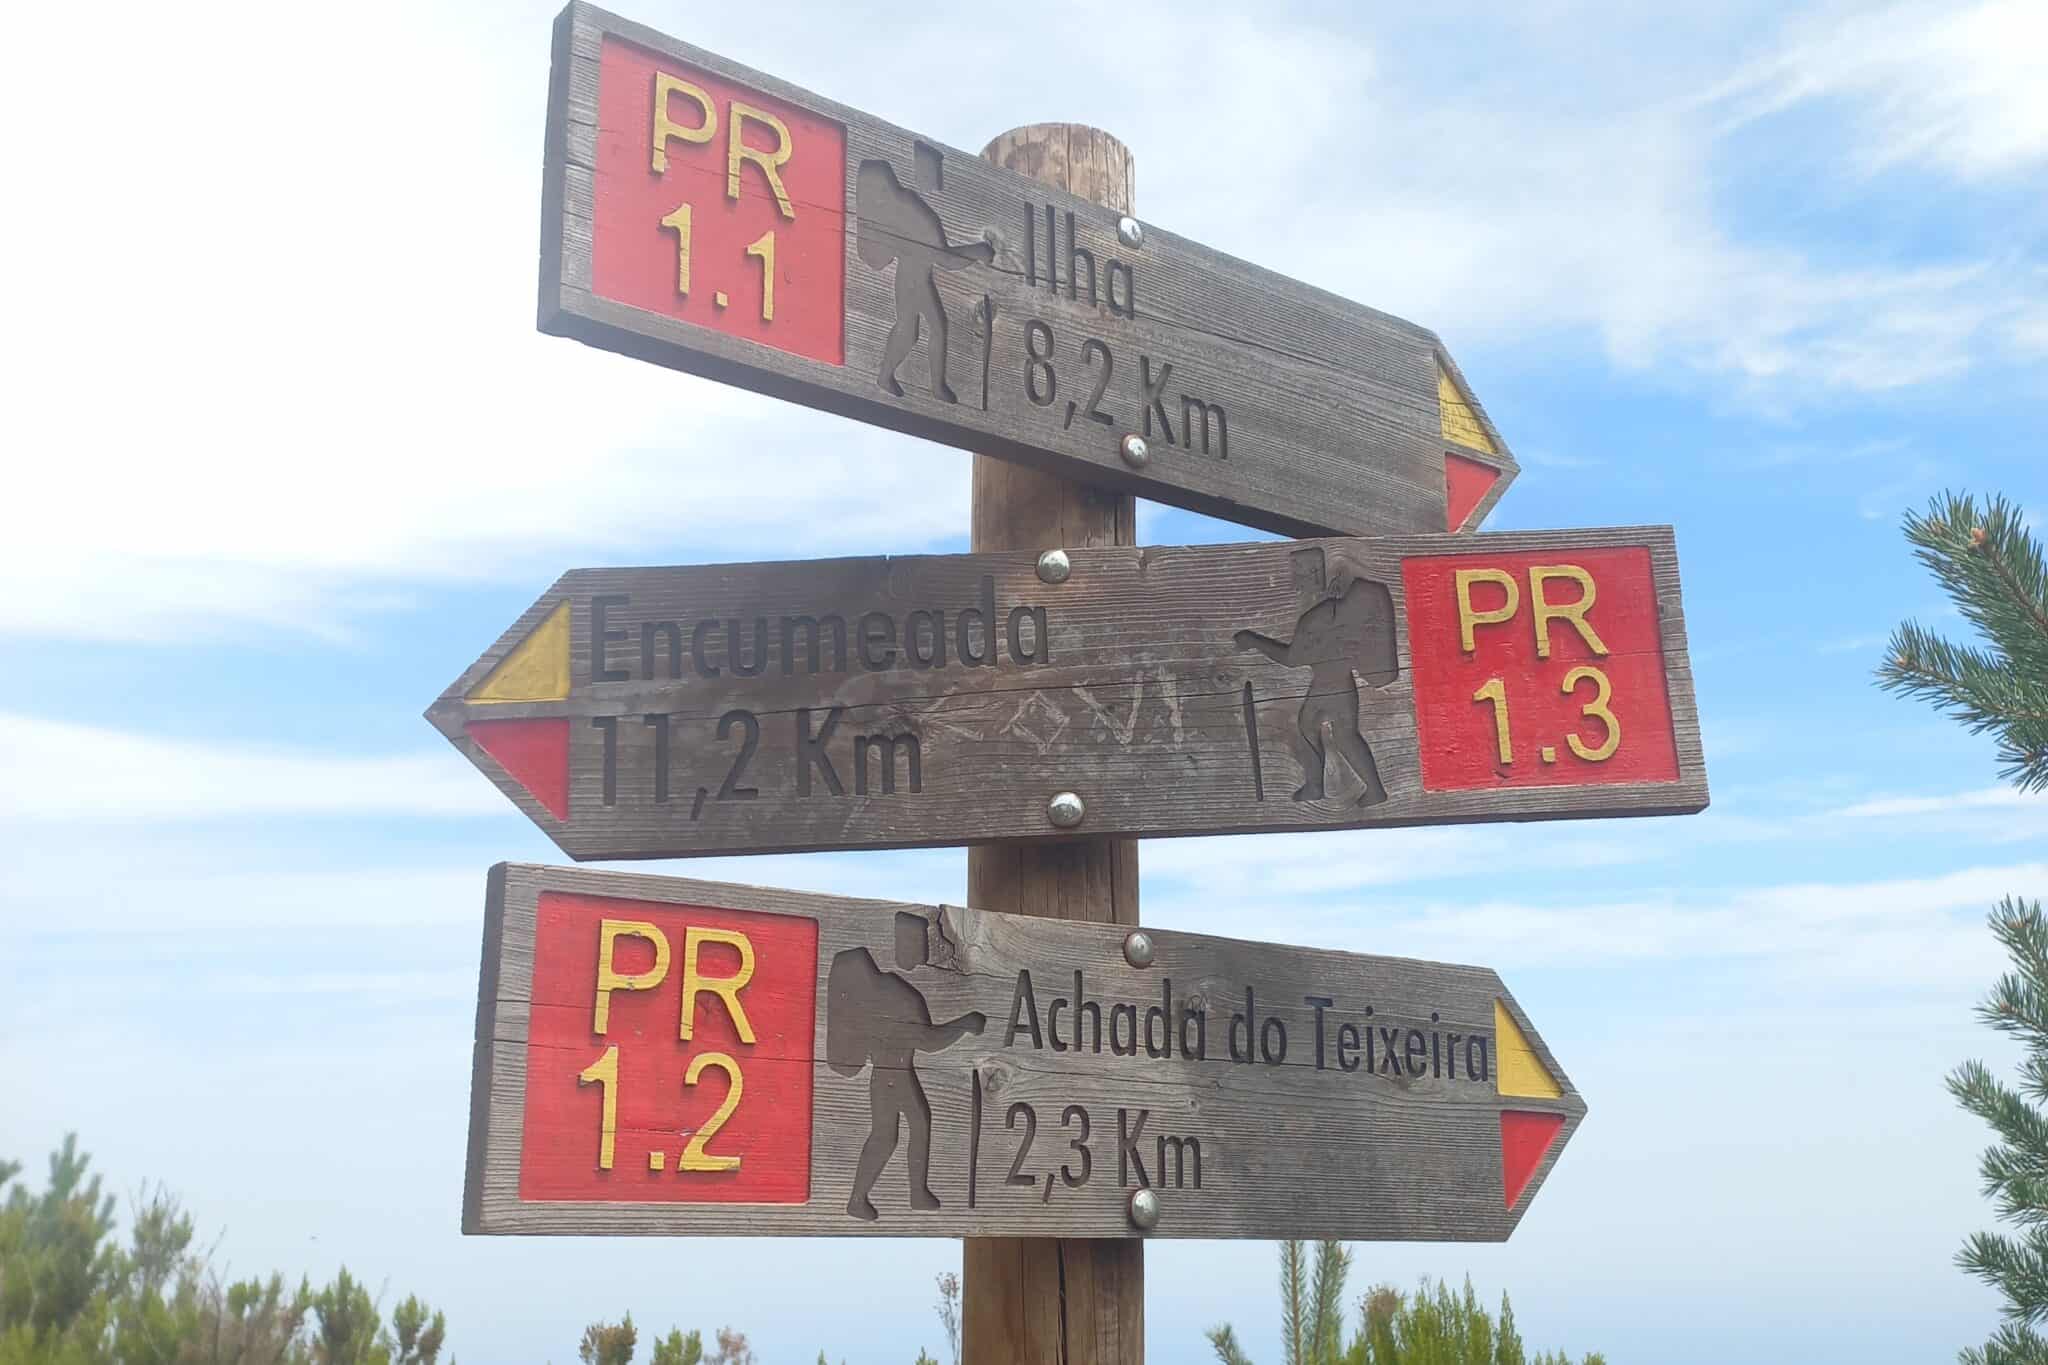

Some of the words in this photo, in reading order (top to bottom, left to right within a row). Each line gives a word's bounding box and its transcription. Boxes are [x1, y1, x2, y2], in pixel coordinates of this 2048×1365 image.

[650, 71, 795, 221] PR
[660, 203, 775, 321] 1.1
[1023, 201, 1135, 320] Ilha
[1024, 318, 1114, 431] 8,2
[1139, 355, 1228, 461] Km
[591, 575, 1049, 683] Encumeada
[1454, 565, 1610, 658] PR
[592, 708, 759, 822] 11,2
[799, 707, 922, 798] Km
[1474, 666, 1621, 765] 1.3
[594, 919, 756, 1044] PR
[1003, 969, 1206, 1062] Achada
[1228, 986, 1288, 1065] do
[1305, 996, 1490, 1083] Teixeira
[579, 1045, 741, 1172] 1.2
[1004, 1102, 1092, 1204] 2,3
[1117, 1108, 1201, 1190] Km
